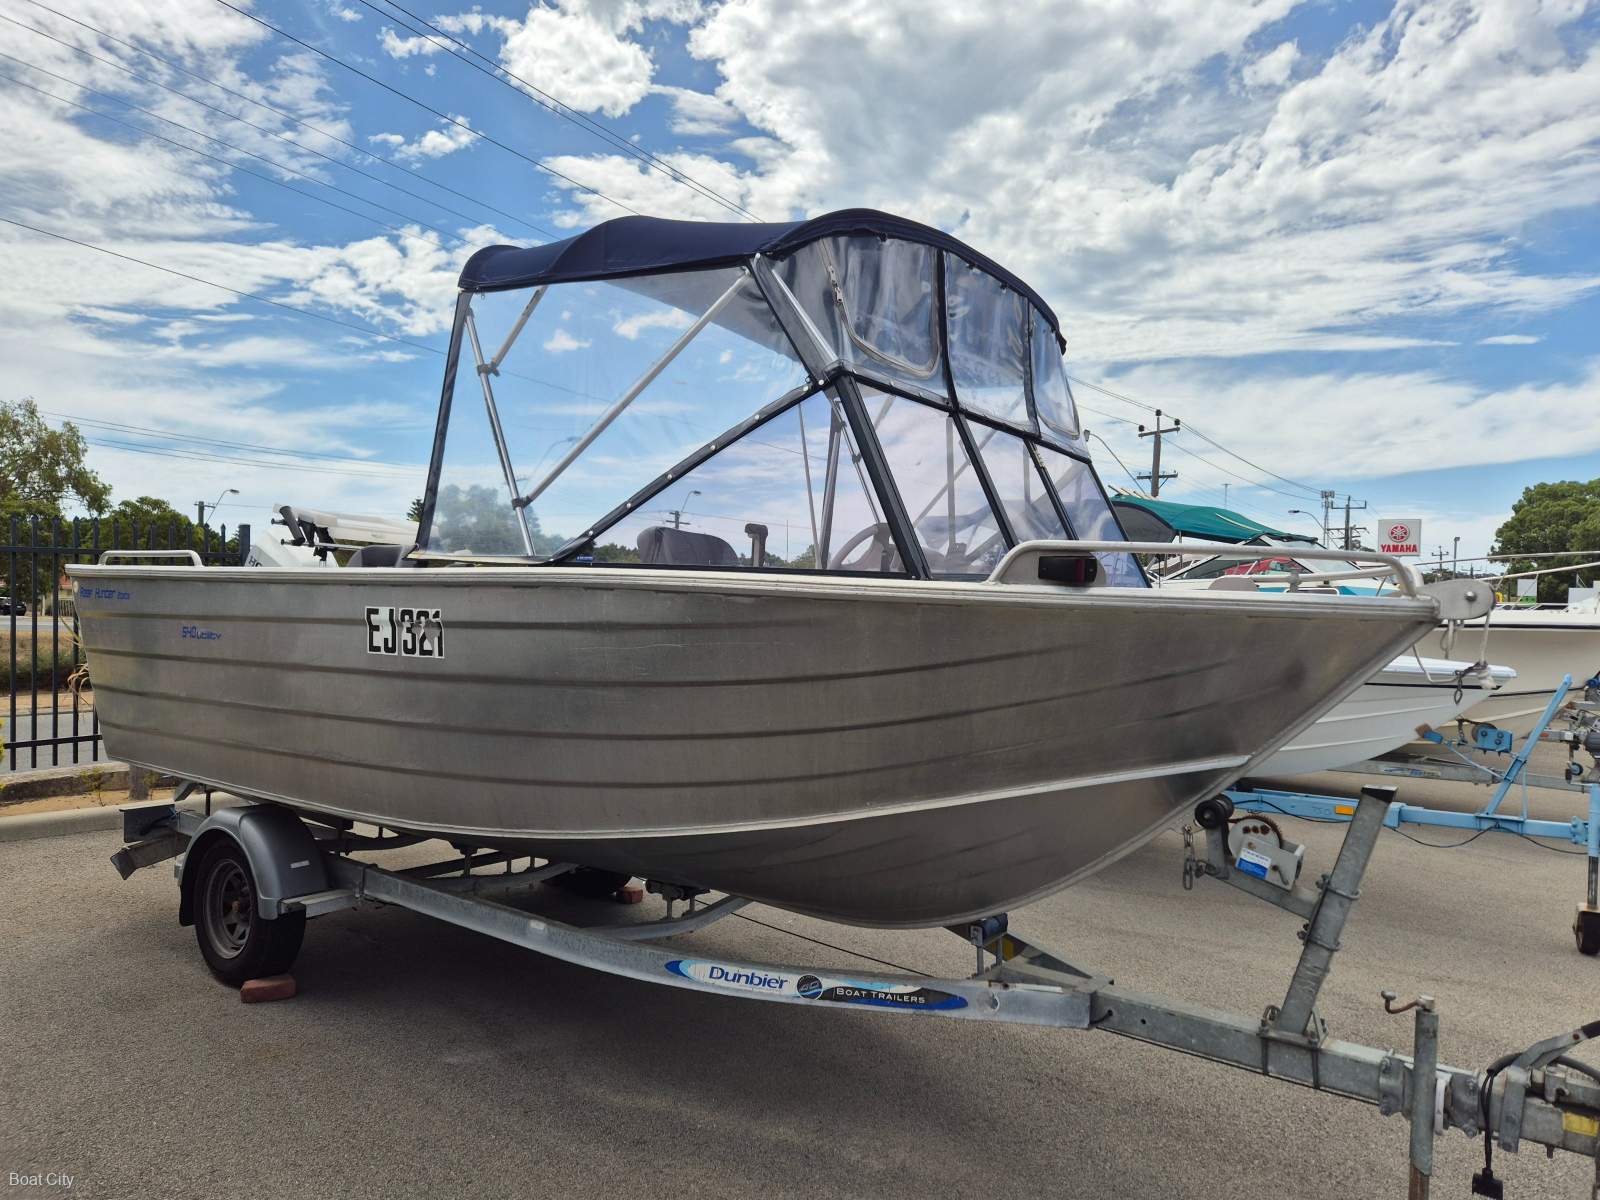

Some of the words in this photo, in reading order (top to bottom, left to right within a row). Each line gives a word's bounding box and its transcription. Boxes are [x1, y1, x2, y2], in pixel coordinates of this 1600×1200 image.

[1381, 544, 1418, 553] YAMAHA
[709, 966, 789, 989] Dunbier
[836, 987, 867, 998] BOAT
[871, 991, 925, 1004] TRAILERS
